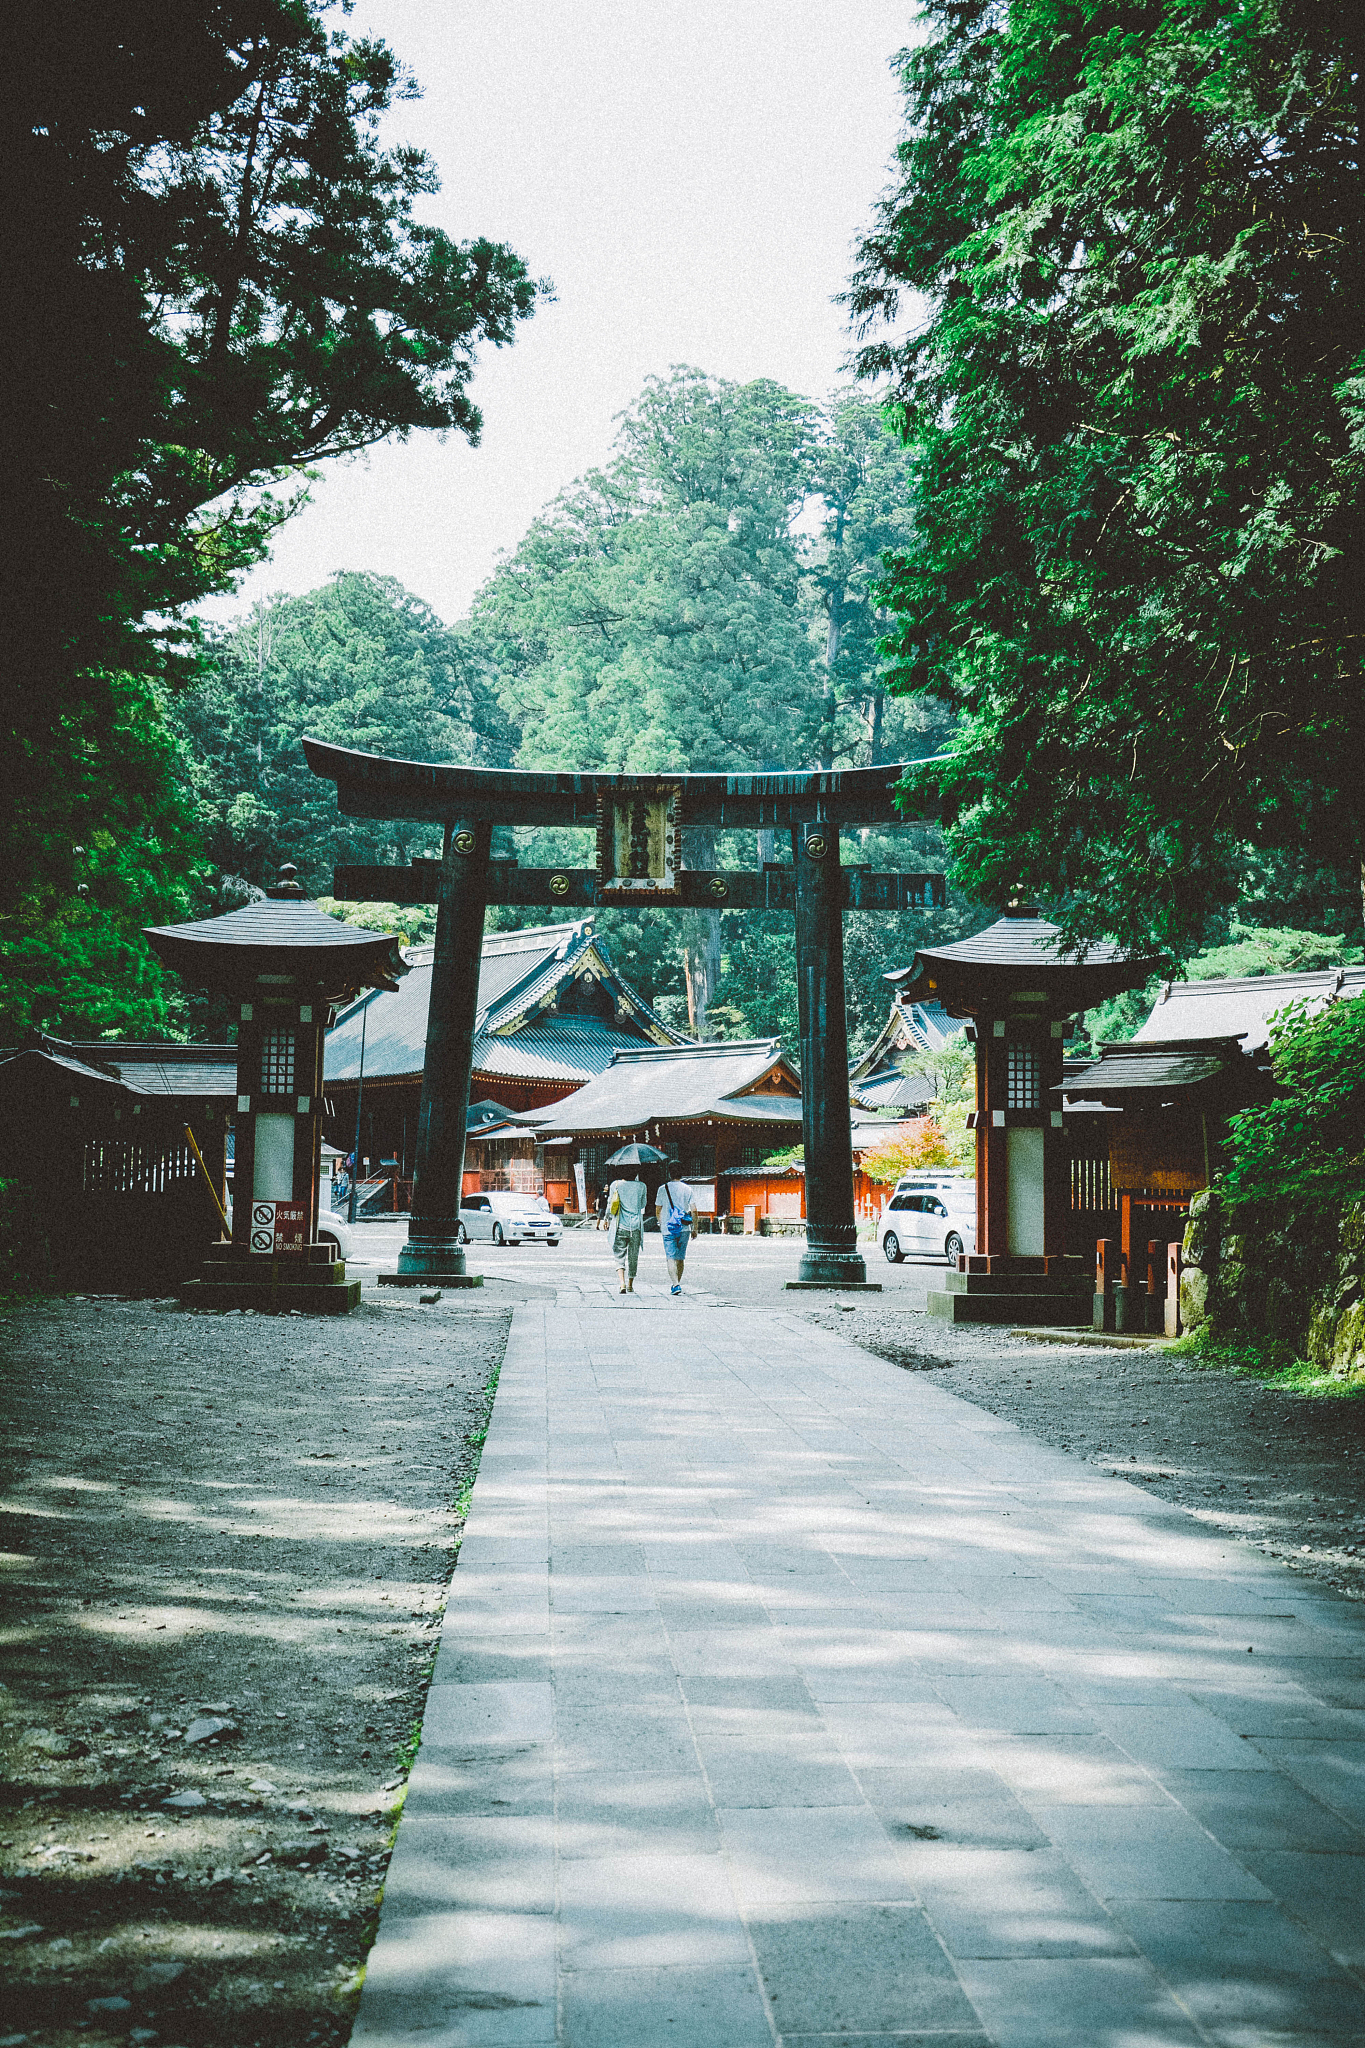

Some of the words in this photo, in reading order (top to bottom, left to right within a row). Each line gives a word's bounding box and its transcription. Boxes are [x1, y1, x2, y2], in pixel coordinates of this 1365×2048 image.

[276, 1210, 304, 1220] 火気厳禁
[275, 1242, 282, 1250] NO
[283, 1243, 303, 1251] SMOKING
